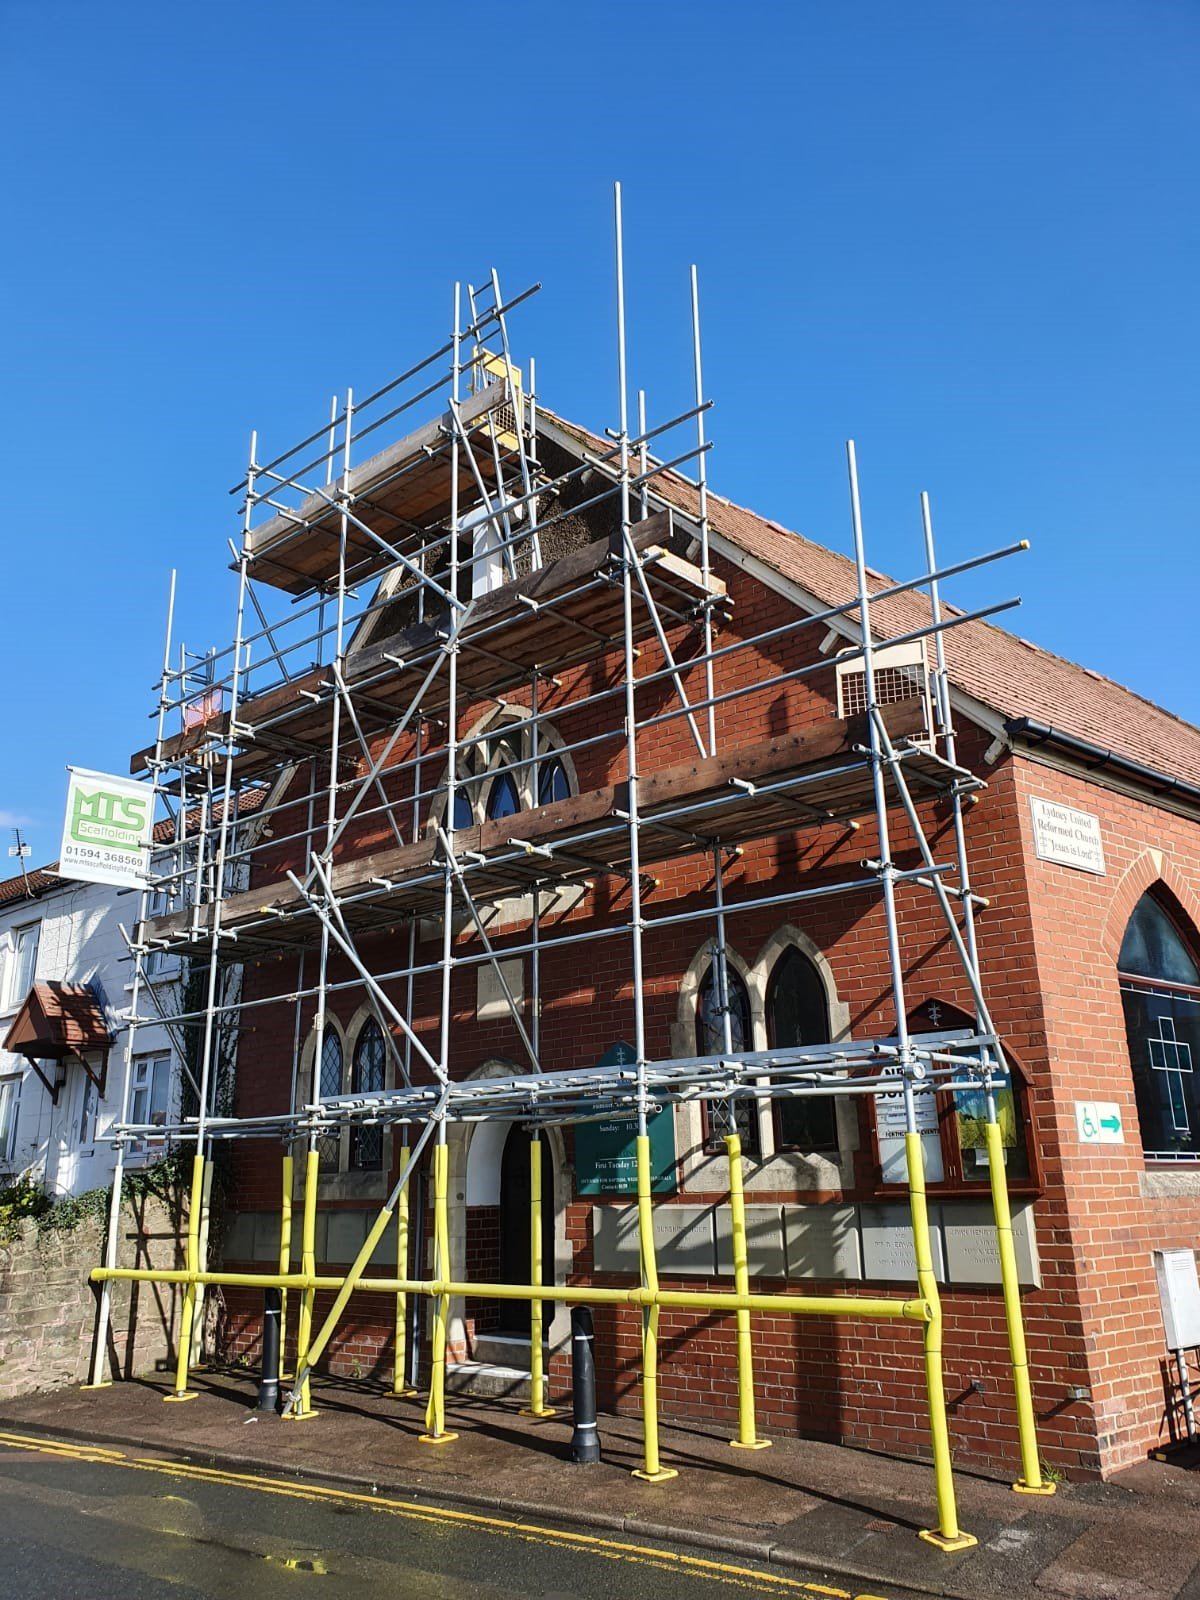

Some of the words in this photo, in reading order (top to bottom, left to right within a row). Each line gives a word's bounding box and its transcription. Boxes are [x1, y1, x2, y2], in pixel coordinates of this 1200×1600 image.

[73, 787, 146, 831] MTS
[1041, 804, 1067, 823] Lydney
[1069, 813, 1092, 829] United
[79, 822, 142, 842] Scaffolding
[1037, 818, 1073, 838] Reformed
[1074, 829, 1099, 846] Church
[65, 846, 101, 859] 01594
[103, 852, 143, 867] 368569
